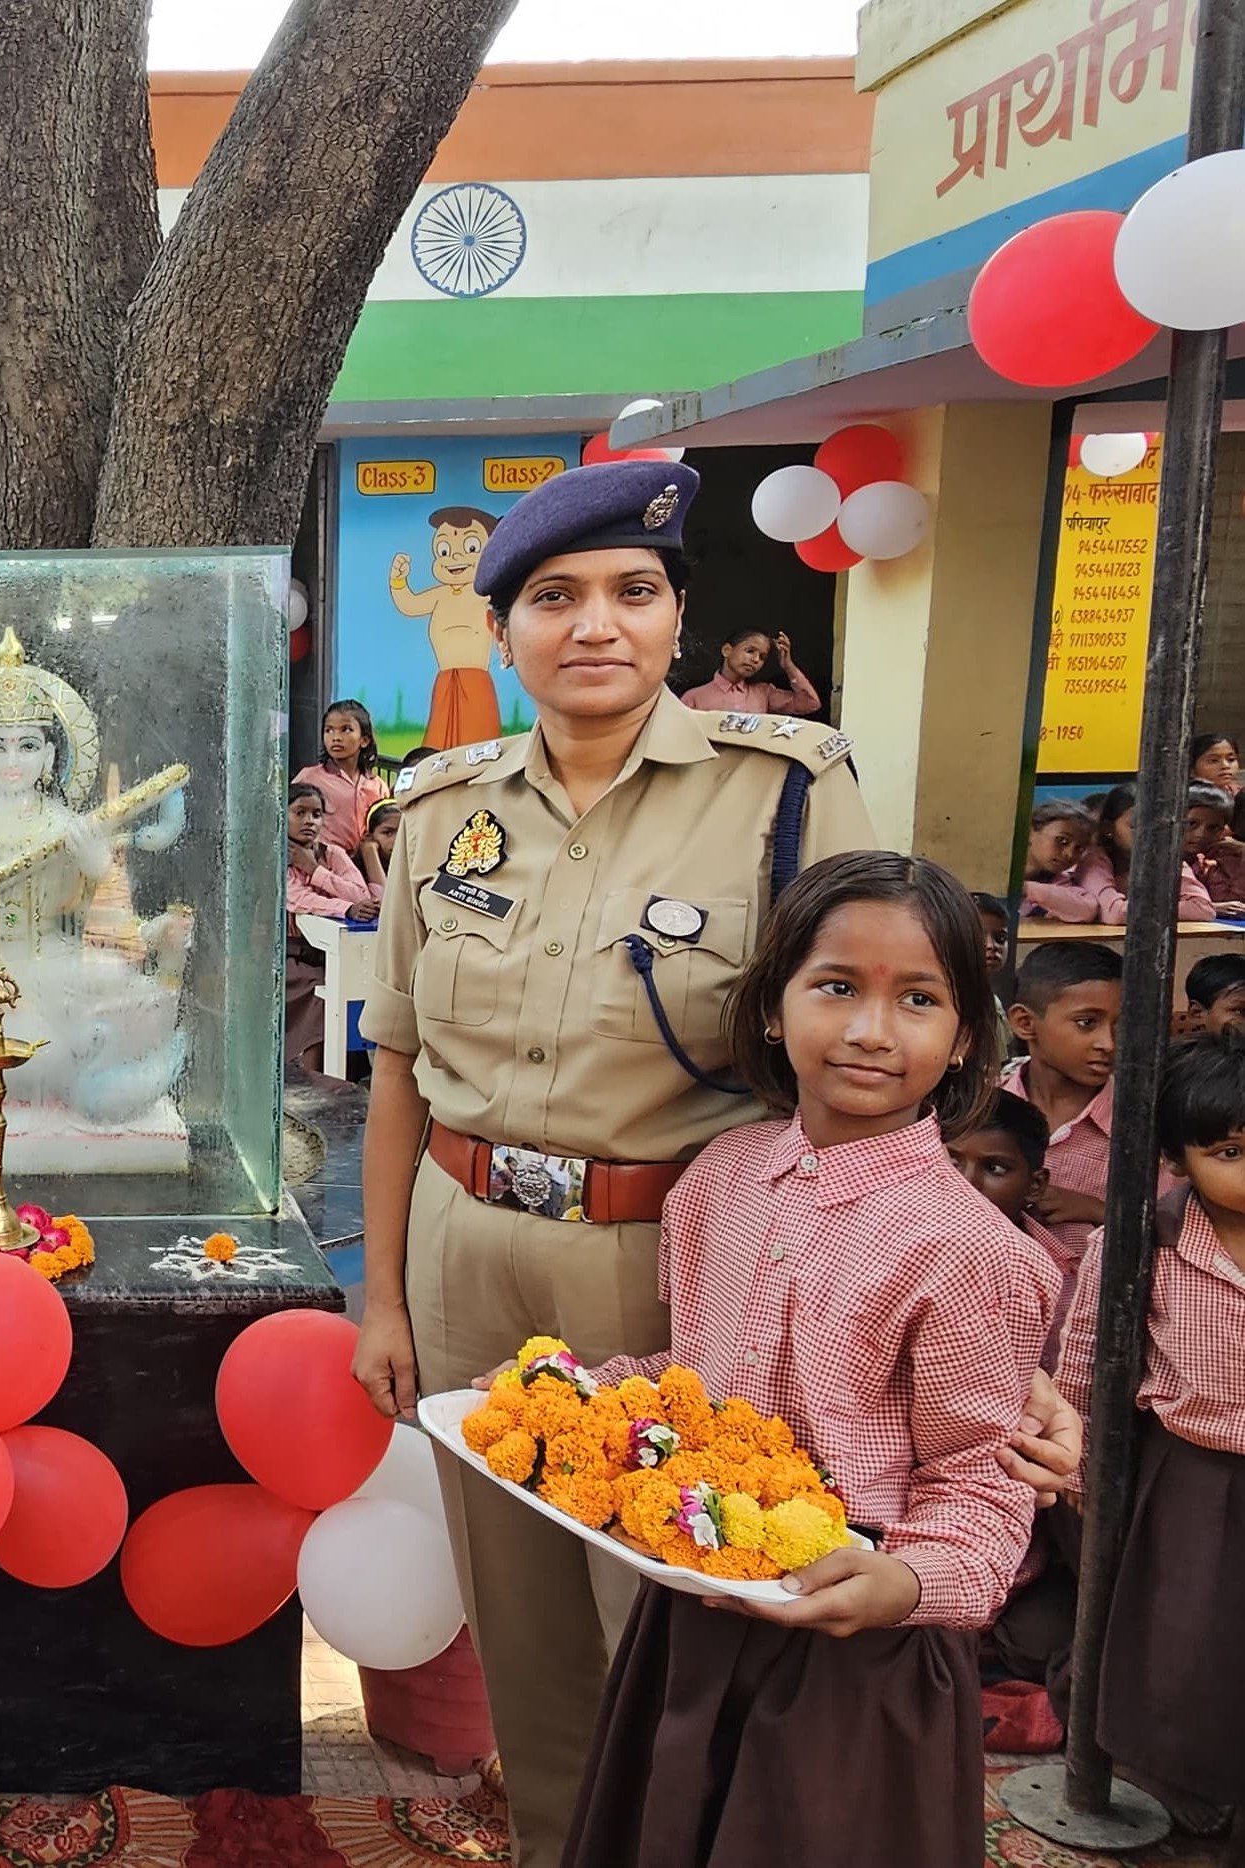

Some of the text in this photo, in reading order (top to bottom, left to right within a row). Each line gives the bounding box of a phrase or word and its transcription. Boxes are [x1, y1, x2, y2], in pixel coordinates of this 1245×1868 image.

[936, 0, 1197, 199] प्राथमि
[362, 465, 427, 488] Class-3
[490, 461, 555, 485] Class-2
[1077, 539, 1148, 555] 9454417552
[1075, 562, 1141, 578] 9454417623
[1073, 585, 1141, 600] 9454416454
[1070, 608, 1135, 624] 6388434937
[447, 889, 490, 909] ARTI SINGH
